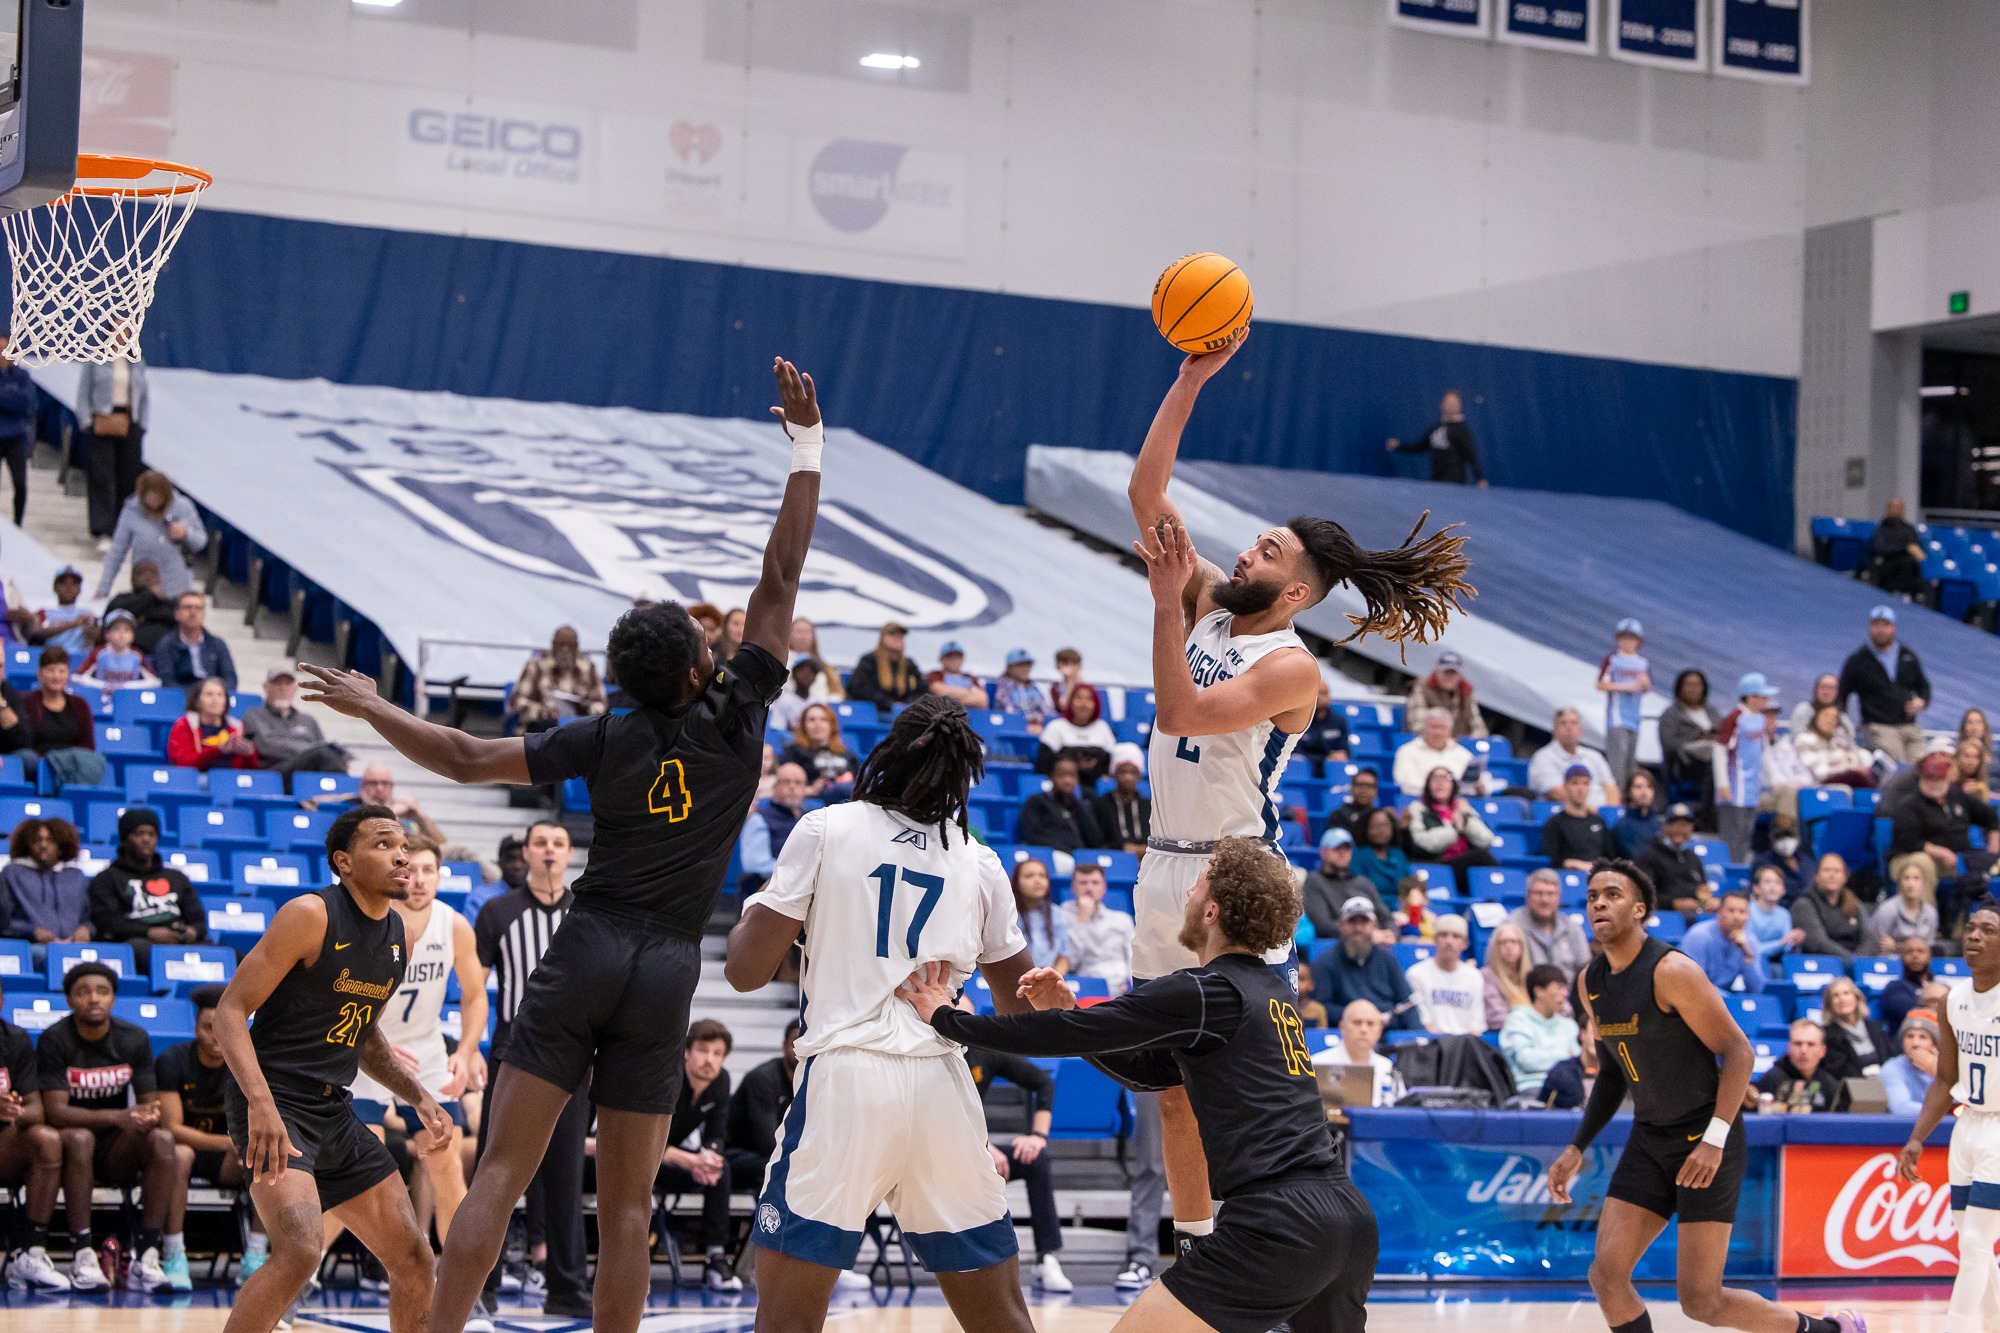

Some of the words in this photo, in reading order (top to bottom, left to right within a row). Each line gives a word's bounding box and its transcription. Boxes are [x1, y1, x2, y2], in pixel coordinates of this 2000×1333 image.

[408, 108, 582, 160] GEICO
[648, 758, 692, 823] 4
[867, 863, 945, 959] 17
[402, 961, 445, 984] USTA
[326, 1001, 372, 1048] 21
[399, 988, 419, 1023] 7
[1269, 998, 1316, 1078] 13
[1617, 1041, 1640, 1082] 1
[1968, 1062, 1986, 1105] 0
[1824, 1153, 1959, 1270] Coca
